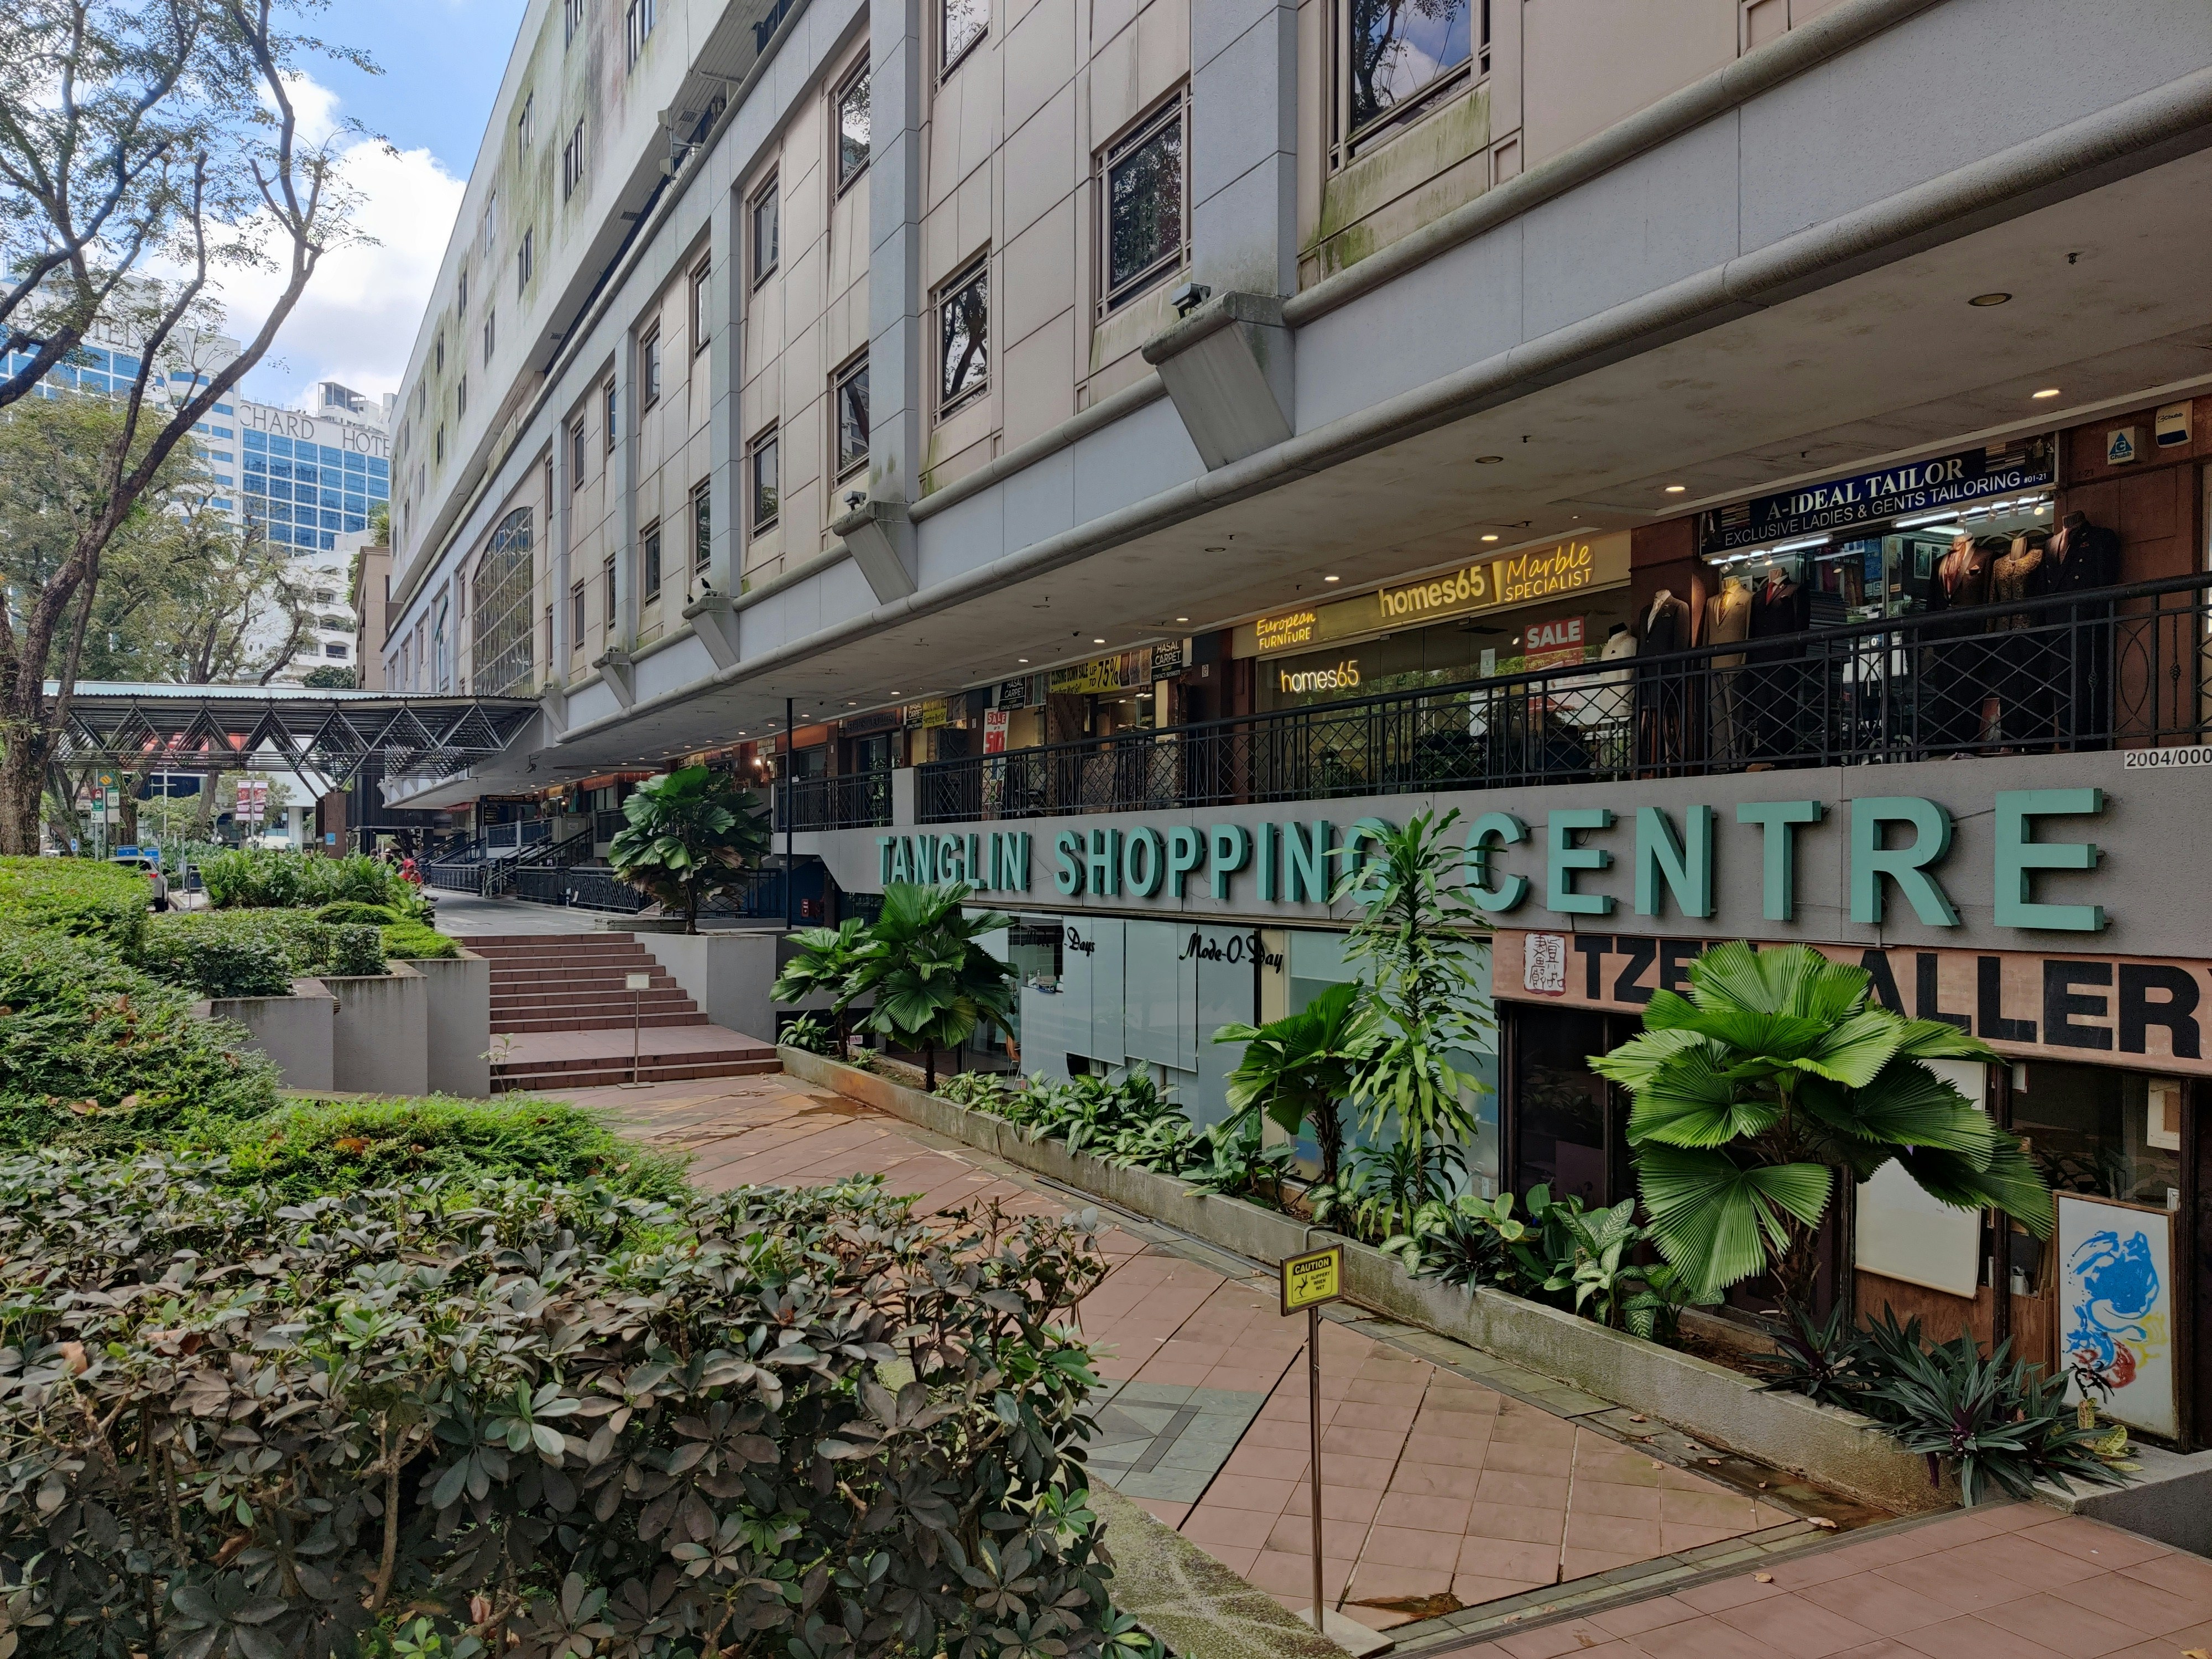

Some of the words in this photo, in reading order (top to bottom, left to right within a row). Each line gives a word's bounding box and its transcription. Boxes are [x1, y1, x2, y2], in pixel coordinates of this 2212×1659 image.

[2110, 452, 2131, 460] Chubb
[1767, 482, 1861, 521] A-IDEAL
[1866, 458, 1964, 497] TAILOR
[1725, 520, 1798, 546] EXCLUSIVE
[1803, 507, 1853, 530] LADIES
[1858, 504, 1866, 519] &
[1872, 491, 1925, 516] GENTS
[1930, 471, 2020, 502] TAILORING
[2024, 473, 2047, 483] #01-21
[1507, 542, 1592, 583] Marble
[1379, 565, 1485, 617] homes65
[1505, 568, 1592, 601] SPECIALIST
[1256, 612, 1317, 636] European
[1527, 620, 1581, 649] SALE
[1157, 641, 1180, 654] HASAL
[1259, 627, 1311, 650] FURNITURE
[1155, 650, 1181, 665] CARPET
[1079, 662, 1088, 679] SALE
[1090, 665, 1097, 676] UP
[1098, 656, 1119, 688] 75%
[1281, 660, 1360, 693] homes65
[1004, 687, 1024, 698] CARPET
[1007, 679, 1023, 688] HASAL
[1089, 678, 1096, 687] TO
[988, 712, 1006, 724] SALE
[2127, 748, 2212, 766] 2004/000
[876, 831, 1027, 890] TANGLIN
[1054, 817, 1397, 906] SHOPPING
[1464, 787, 2104, 931] CENTRE
[1179, 932, 1283, 974] Mode-O-Day
[1574, 935, 1759, 1004] TZE
[1859, 950, 2212, 1060] ALLER
[1295, 1258, 1329, 1274] CAUTION
[1310, 1271, 1330, 1280] SLIPPERY
